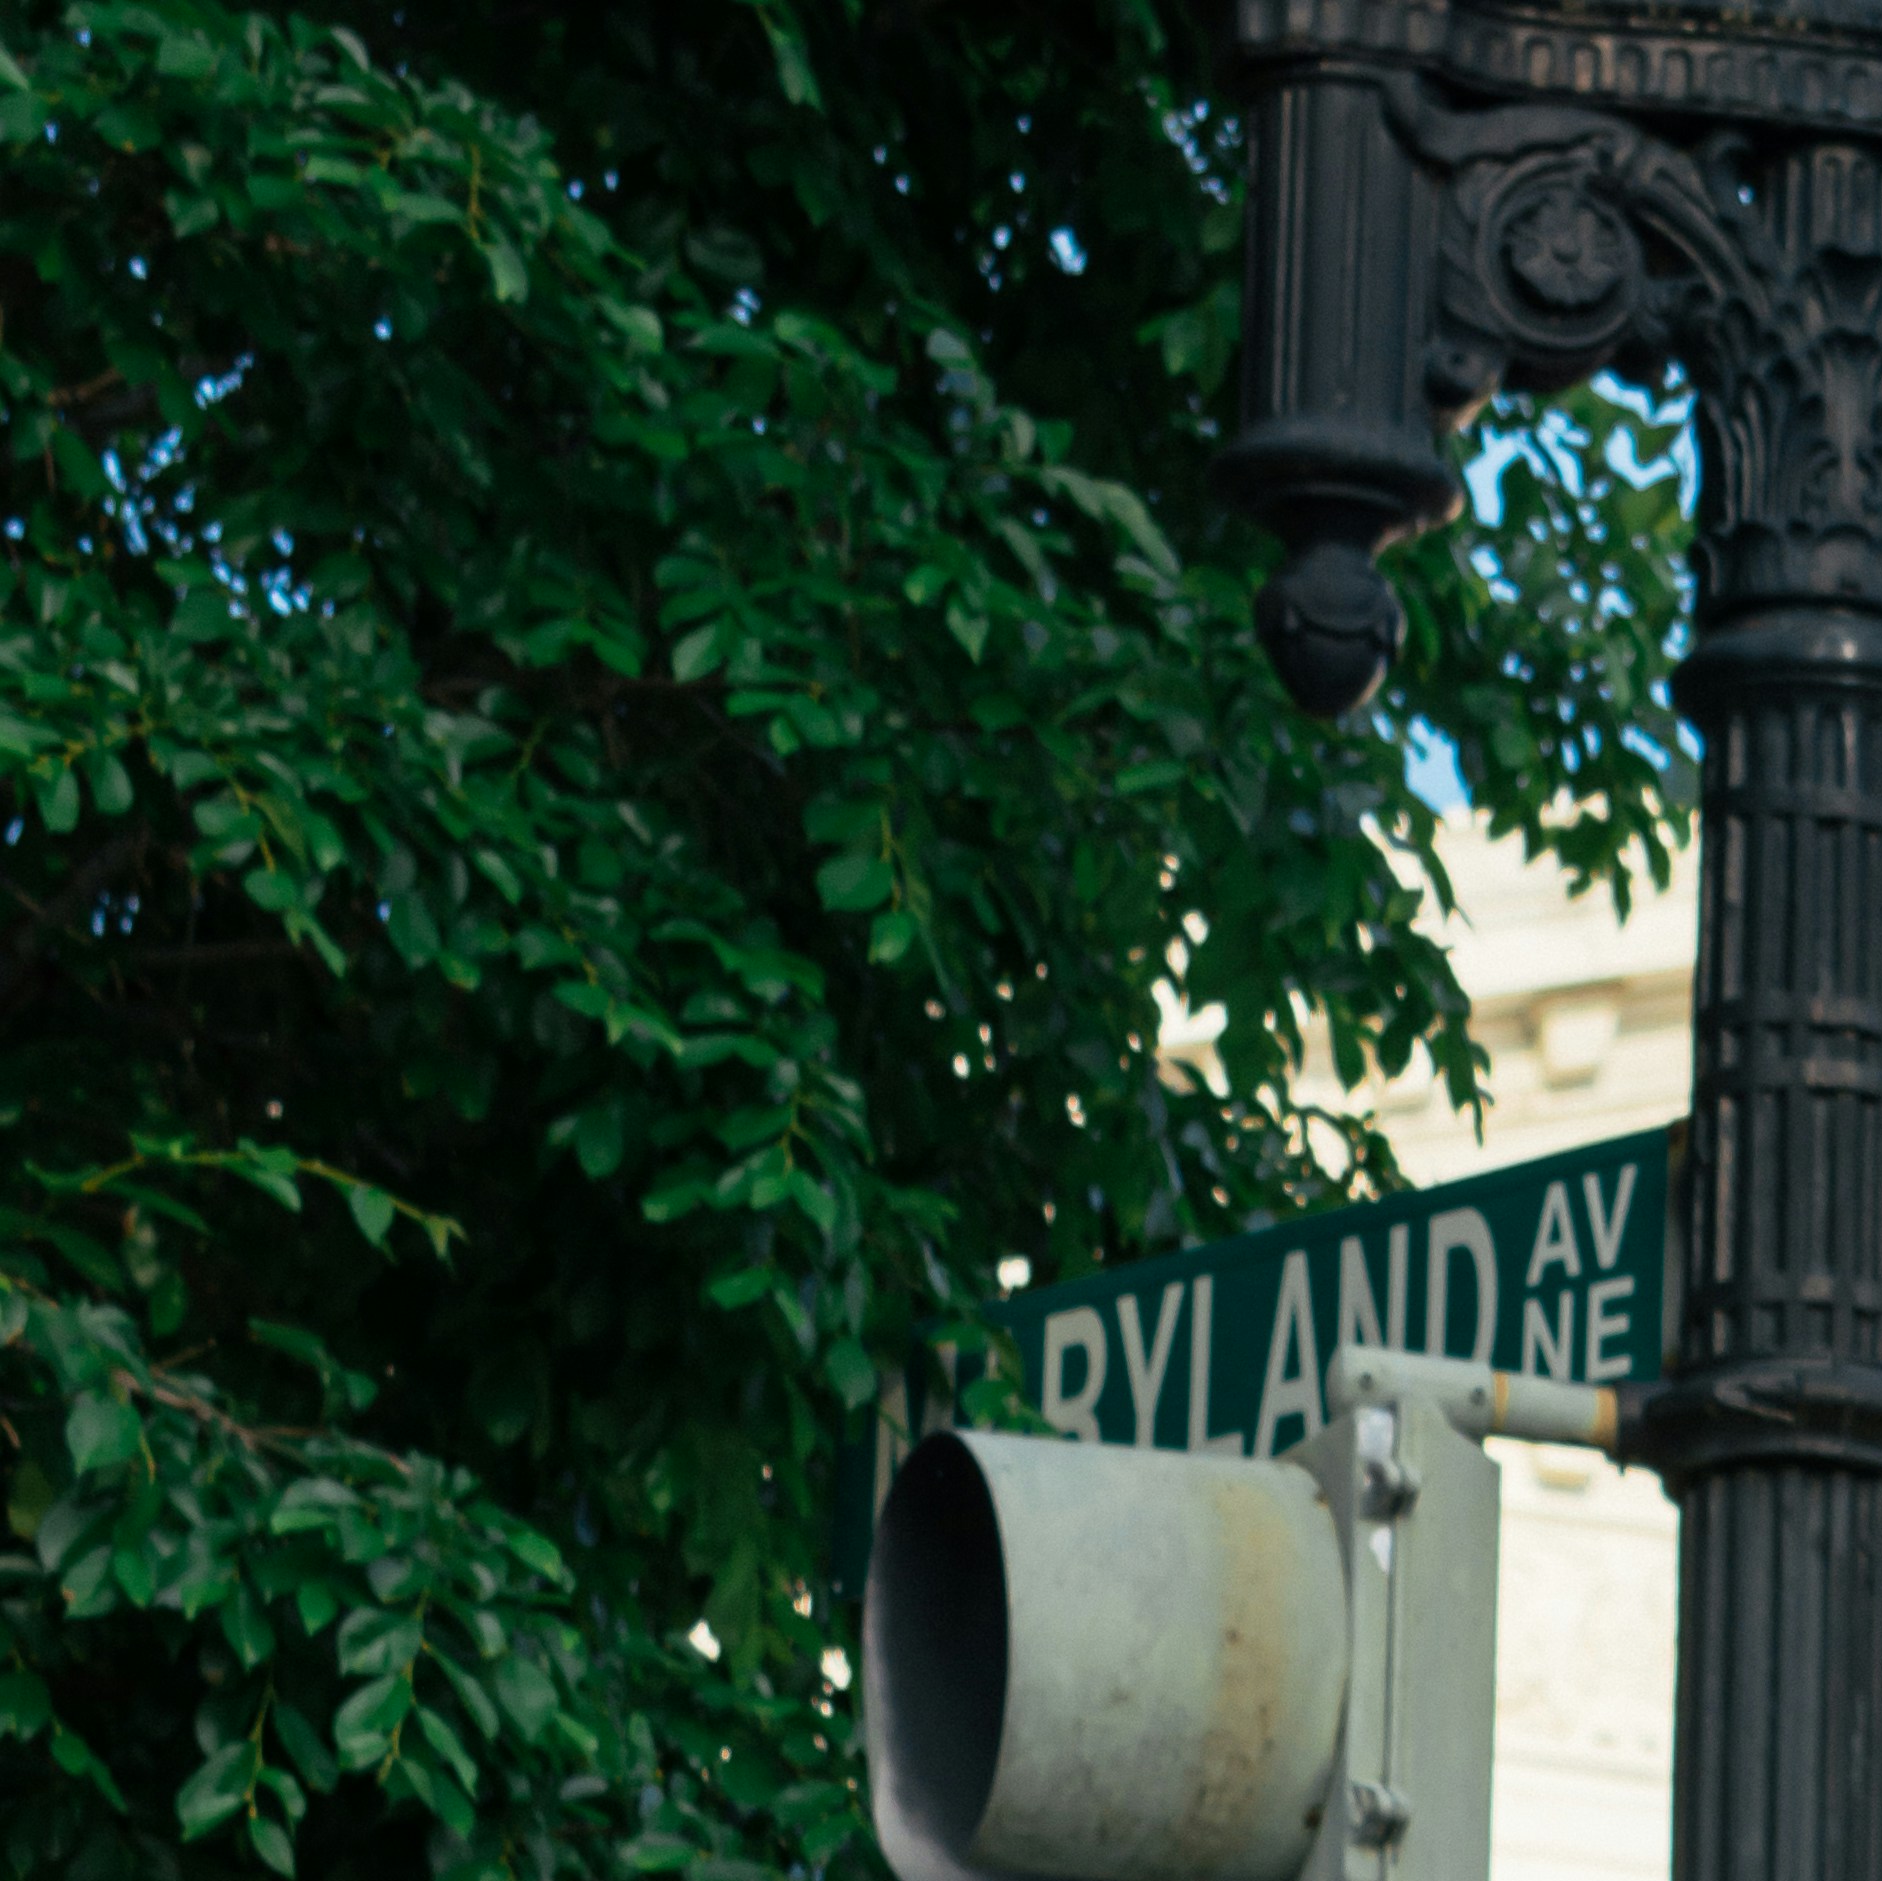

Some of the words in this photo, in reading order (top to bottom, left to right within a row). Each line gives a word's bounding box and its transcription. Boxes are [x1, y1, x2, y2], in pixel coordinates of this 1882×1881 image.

[874, 1205, 1497, 1500] RYLAND
[1525, 1163, 1639, 1286] AV
[1521, 1276, 1636, 1381] NE
